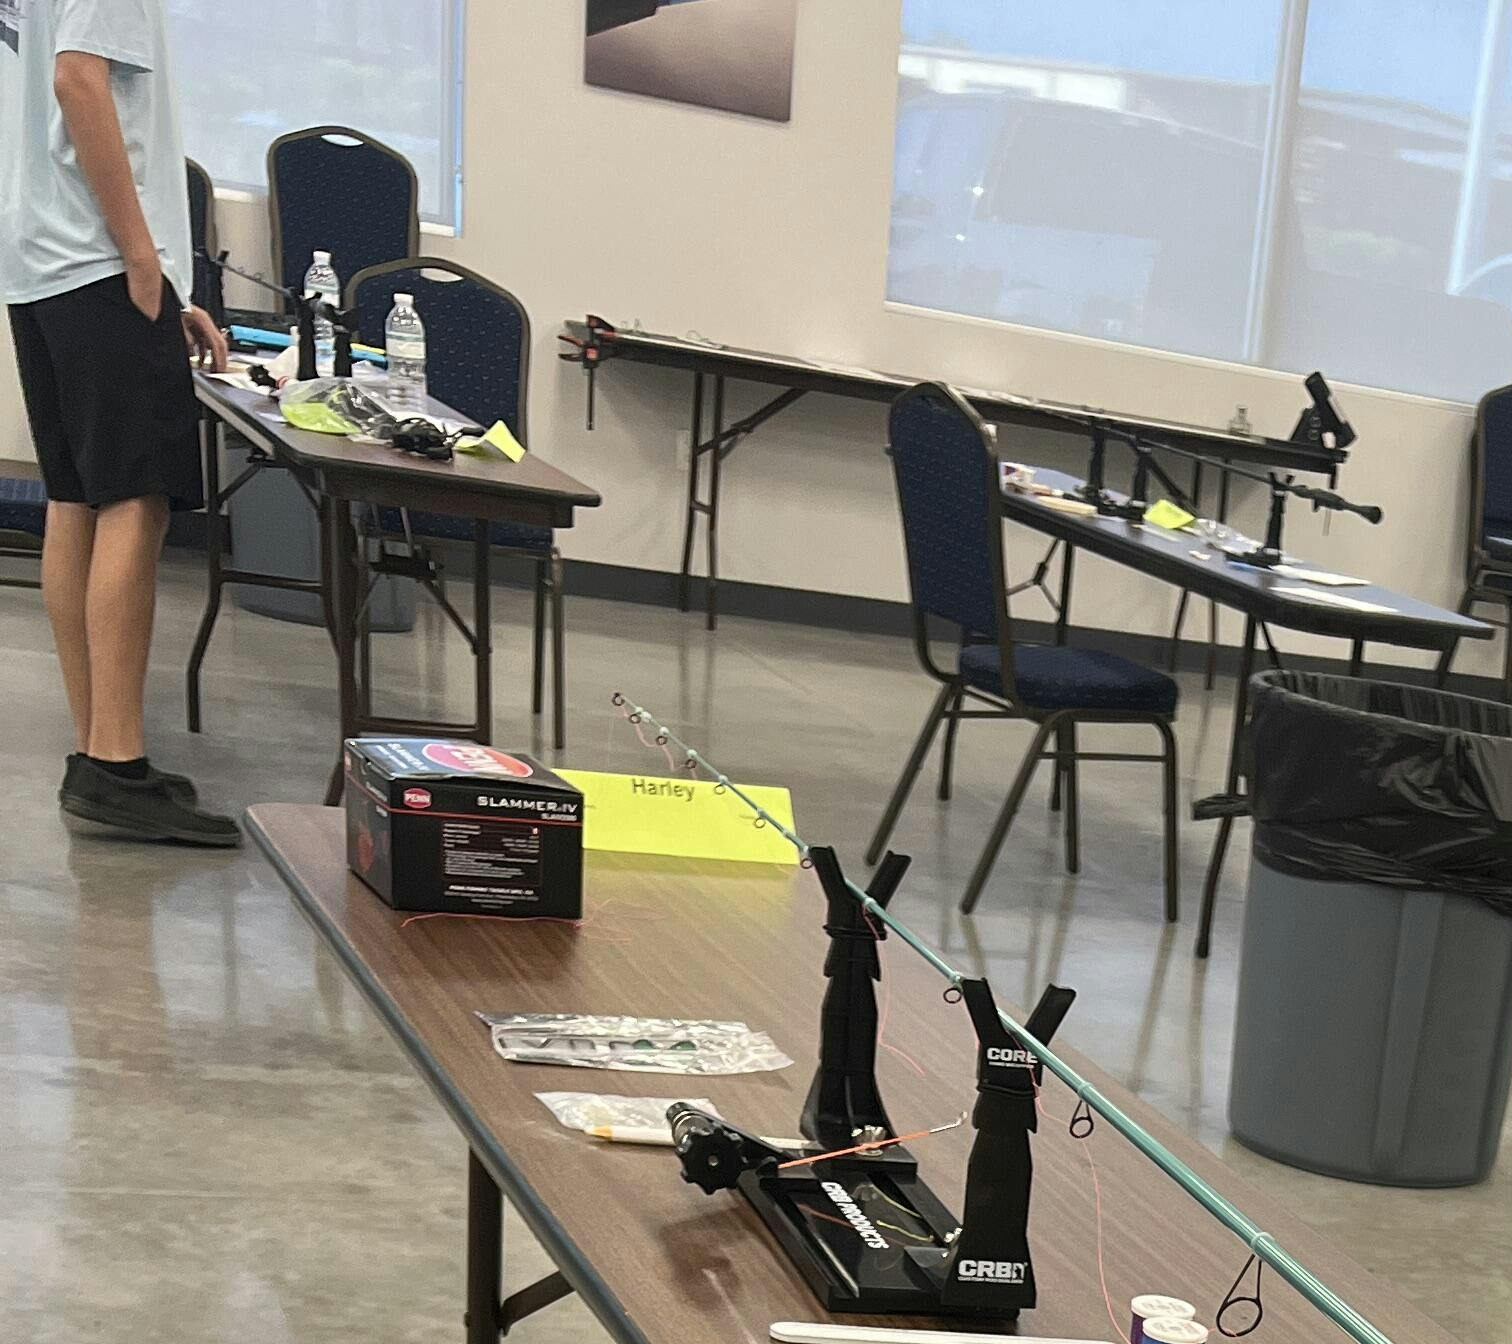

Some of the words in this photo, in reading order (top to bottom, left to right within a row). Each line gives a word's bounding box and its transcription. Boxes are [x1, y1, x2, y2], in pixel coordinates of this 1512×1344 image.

[631, 778, 695, 802] Harley
[987, 1047, 1039, 1064] CORE
[840, 1202, 889, 1249] PRODUCTS
